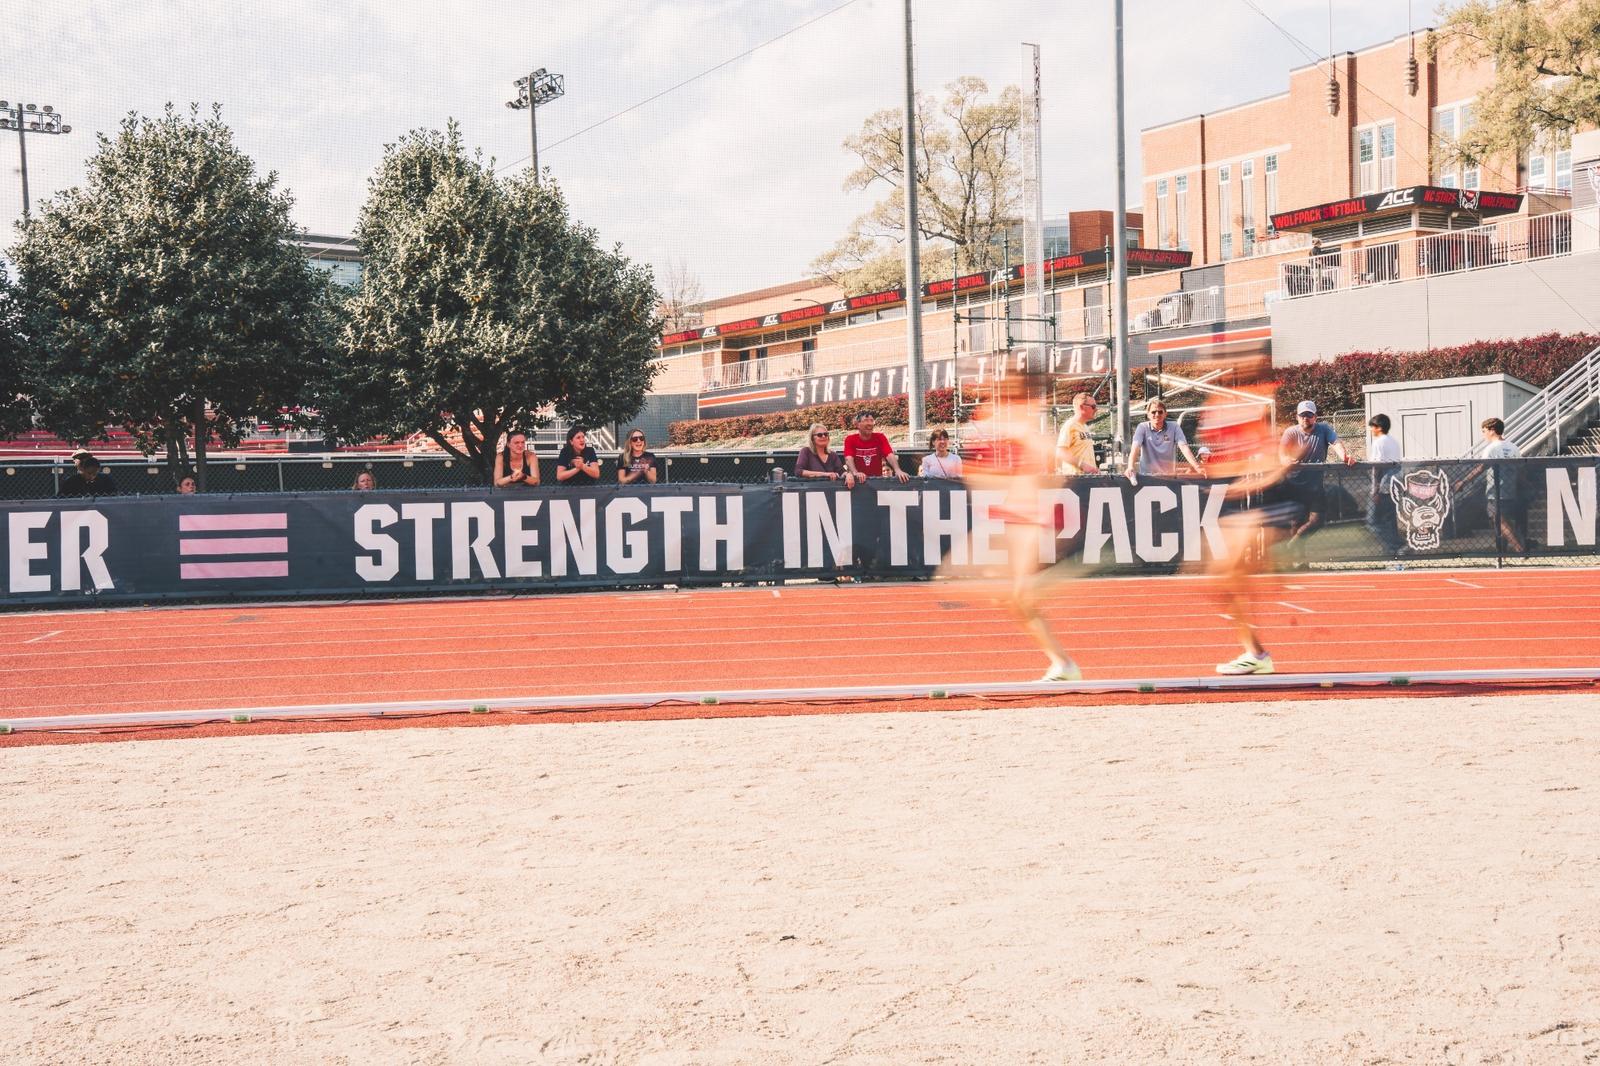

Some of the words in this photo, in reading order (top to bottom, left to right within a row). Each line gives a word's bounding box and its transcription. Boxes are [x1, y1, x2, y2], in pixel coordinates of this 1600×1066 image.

[1274, 208, 1321, 229] WOLFPACK
[1323, 198, 1367, 219] SOFTBALL
[1378, 188, 1415, 208] ACC
[830, 300, 847, 312] ACC
[931, 360, 956, 390] IN
[1545, 466, 1598, 547] N
[354, 494, 744, 582] STRENGTH
[782, 490, 853, 569] IN
[877, 489, 1009, 567] THE
[1038, 483, 1230, 565] PACK
[8, 510, 115, 593] ER
